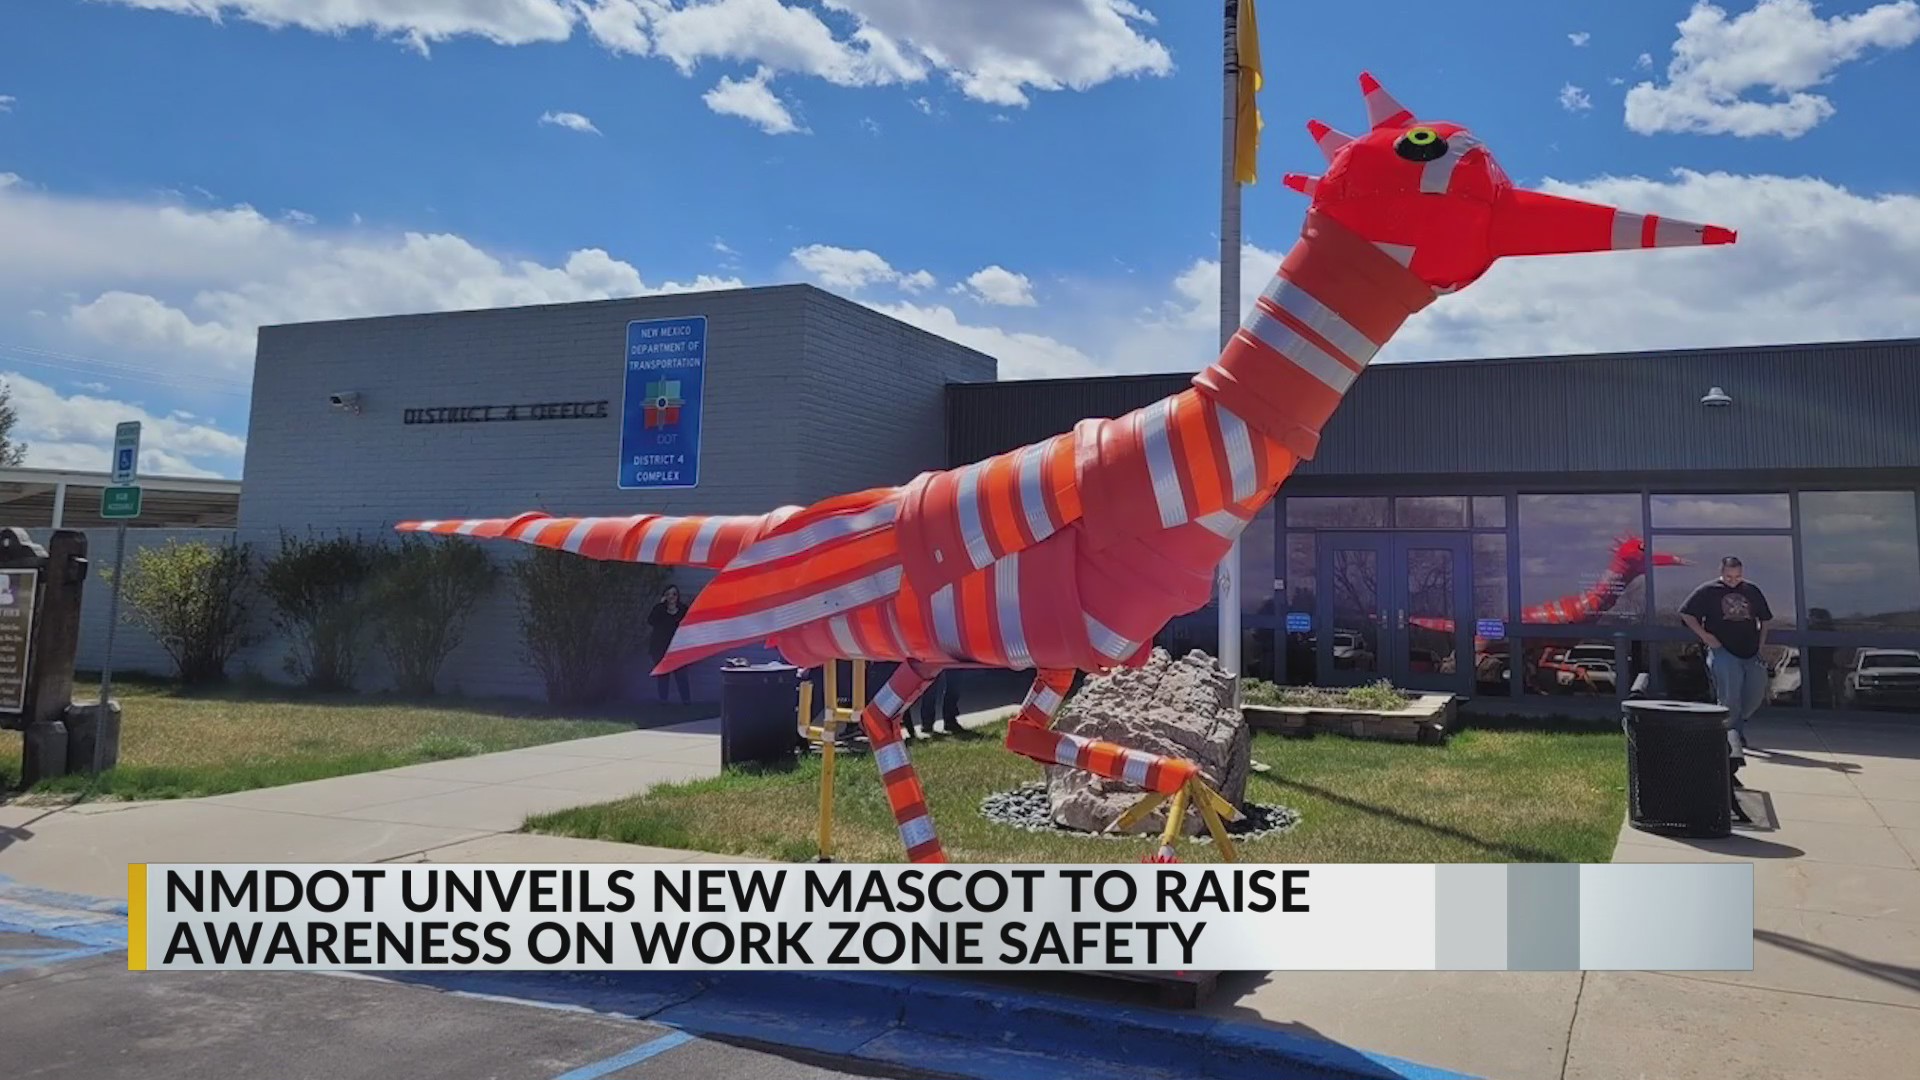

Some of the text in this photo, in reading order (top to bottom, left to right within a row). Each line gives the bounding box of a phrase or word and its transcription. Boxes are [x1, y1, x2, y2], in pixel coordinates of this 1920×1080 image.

[641, 325, 691, 338] NEW MEXICO
[631, 340, 699, 355] DEPARTMENT OF
[629, 357, 700, 371] TRANSPORTATION
[404, 407, 491, 424] DISTRICT
[531, 401, 609, 419] OFFICE
[657, 433, 678, 445] DOT
[633, 453, 685, 466] DISTRICT 4
[636, 471, 680, 483] COMPLEX
